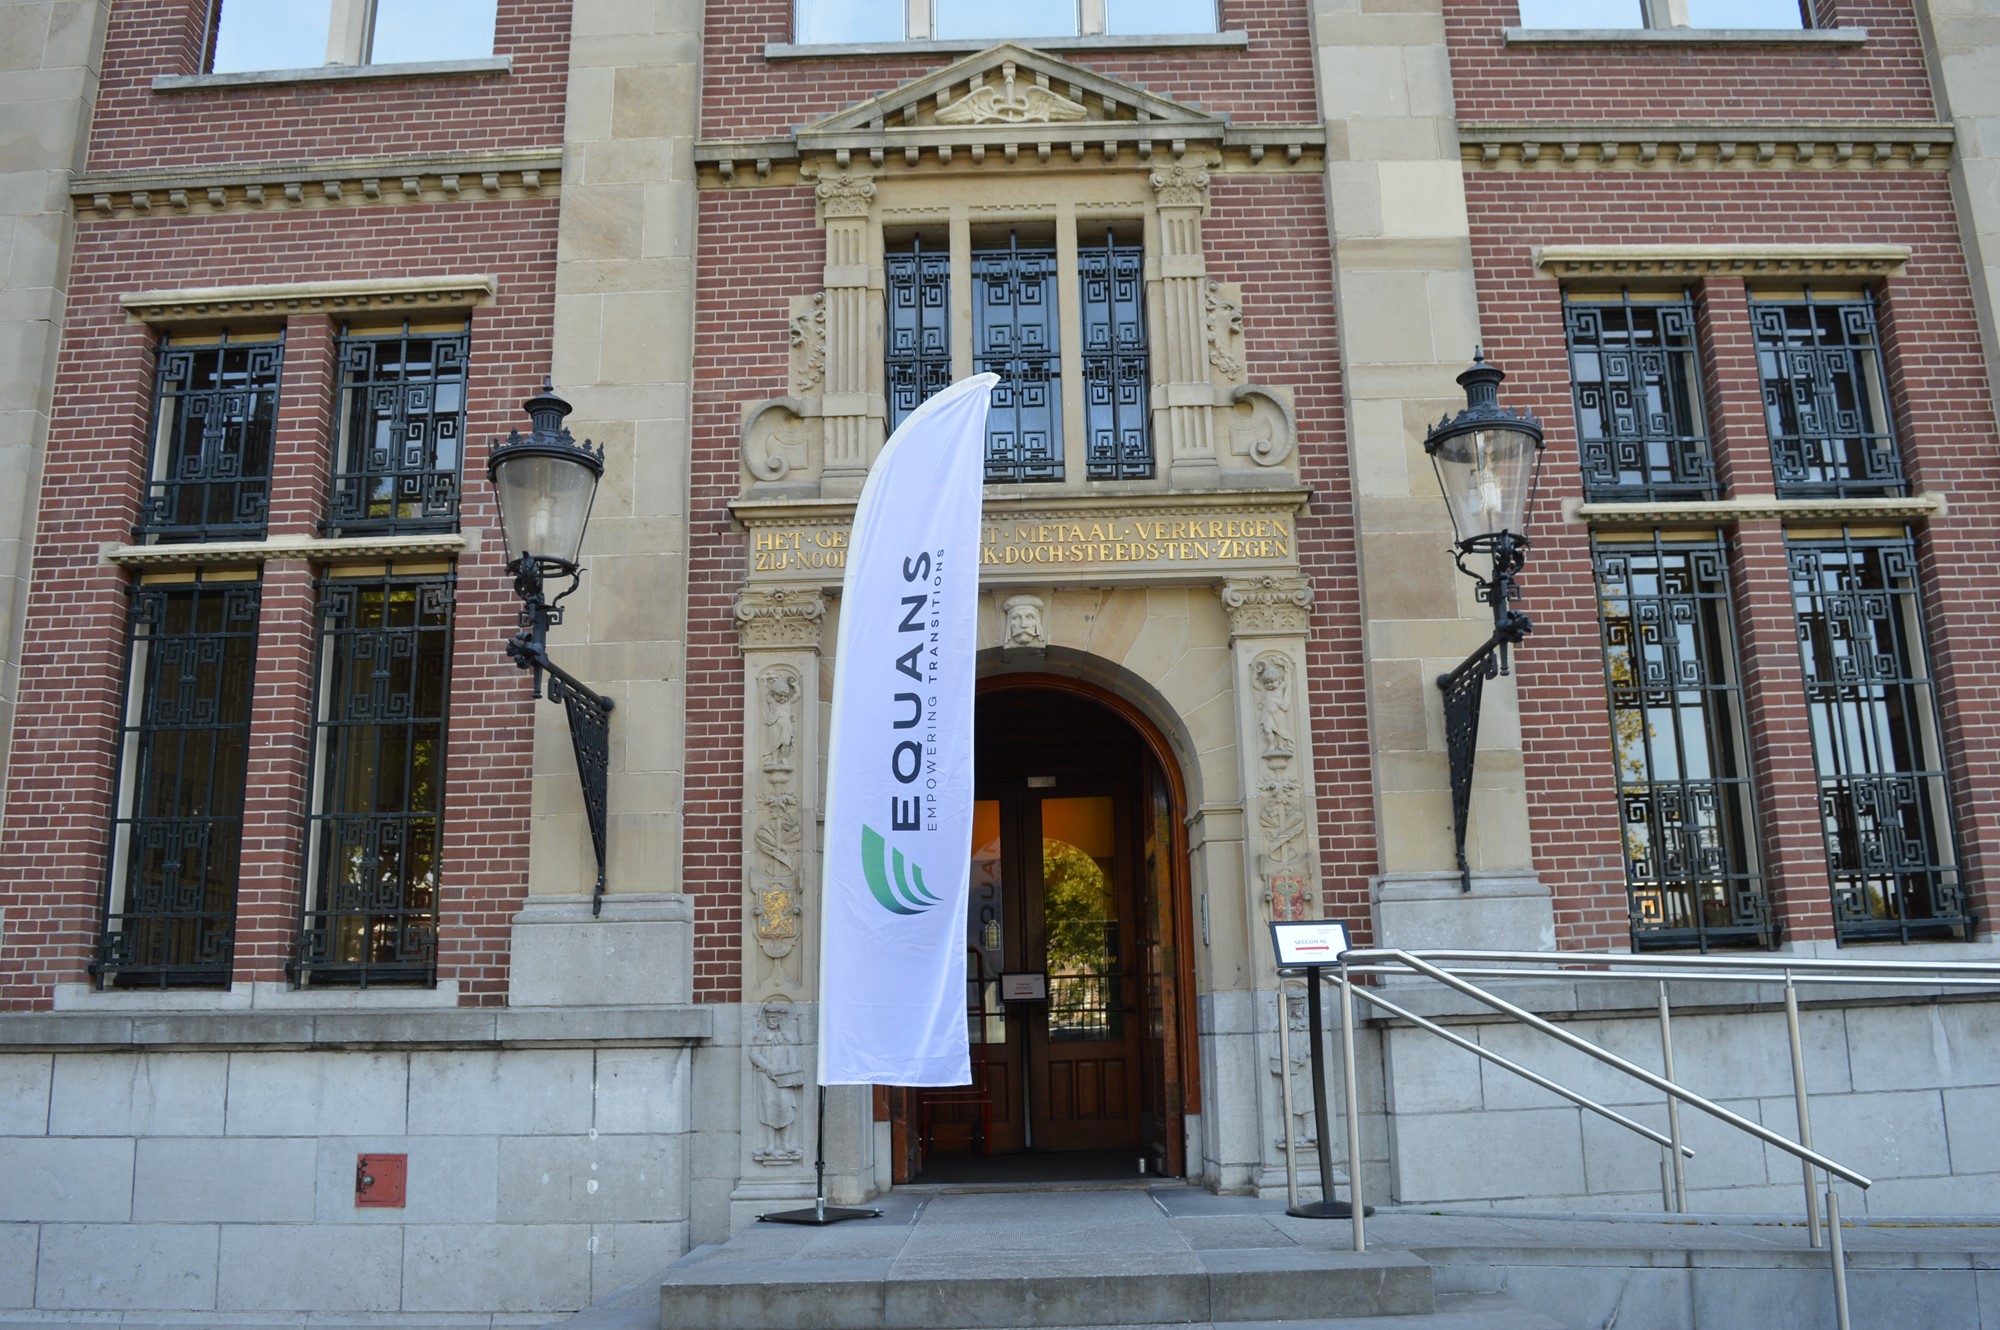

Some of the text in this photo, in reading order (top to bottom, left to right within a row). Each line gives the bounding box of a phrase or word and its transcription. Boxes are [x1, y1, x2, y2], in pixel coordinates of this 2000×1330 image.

[755, 529, 850, 551] HET GE
[1014, 522, 1123, 543] METAAL
[1135, 519, 1288, 541] VERKREGEN
[755, 550, 848, 571] ZIJ NOOI
[1004, 545, 1064, 565] DOCH
[1070, 541, 1160, 562] STEEDS
[1164, 540, 1209, 560] TEN
[1217, 538, 1288, 559] ZEGEN
[891, 551, 932, 831] EQUANS
[926, 549, 945, 831] EMPOWERING TRANSITIONS
